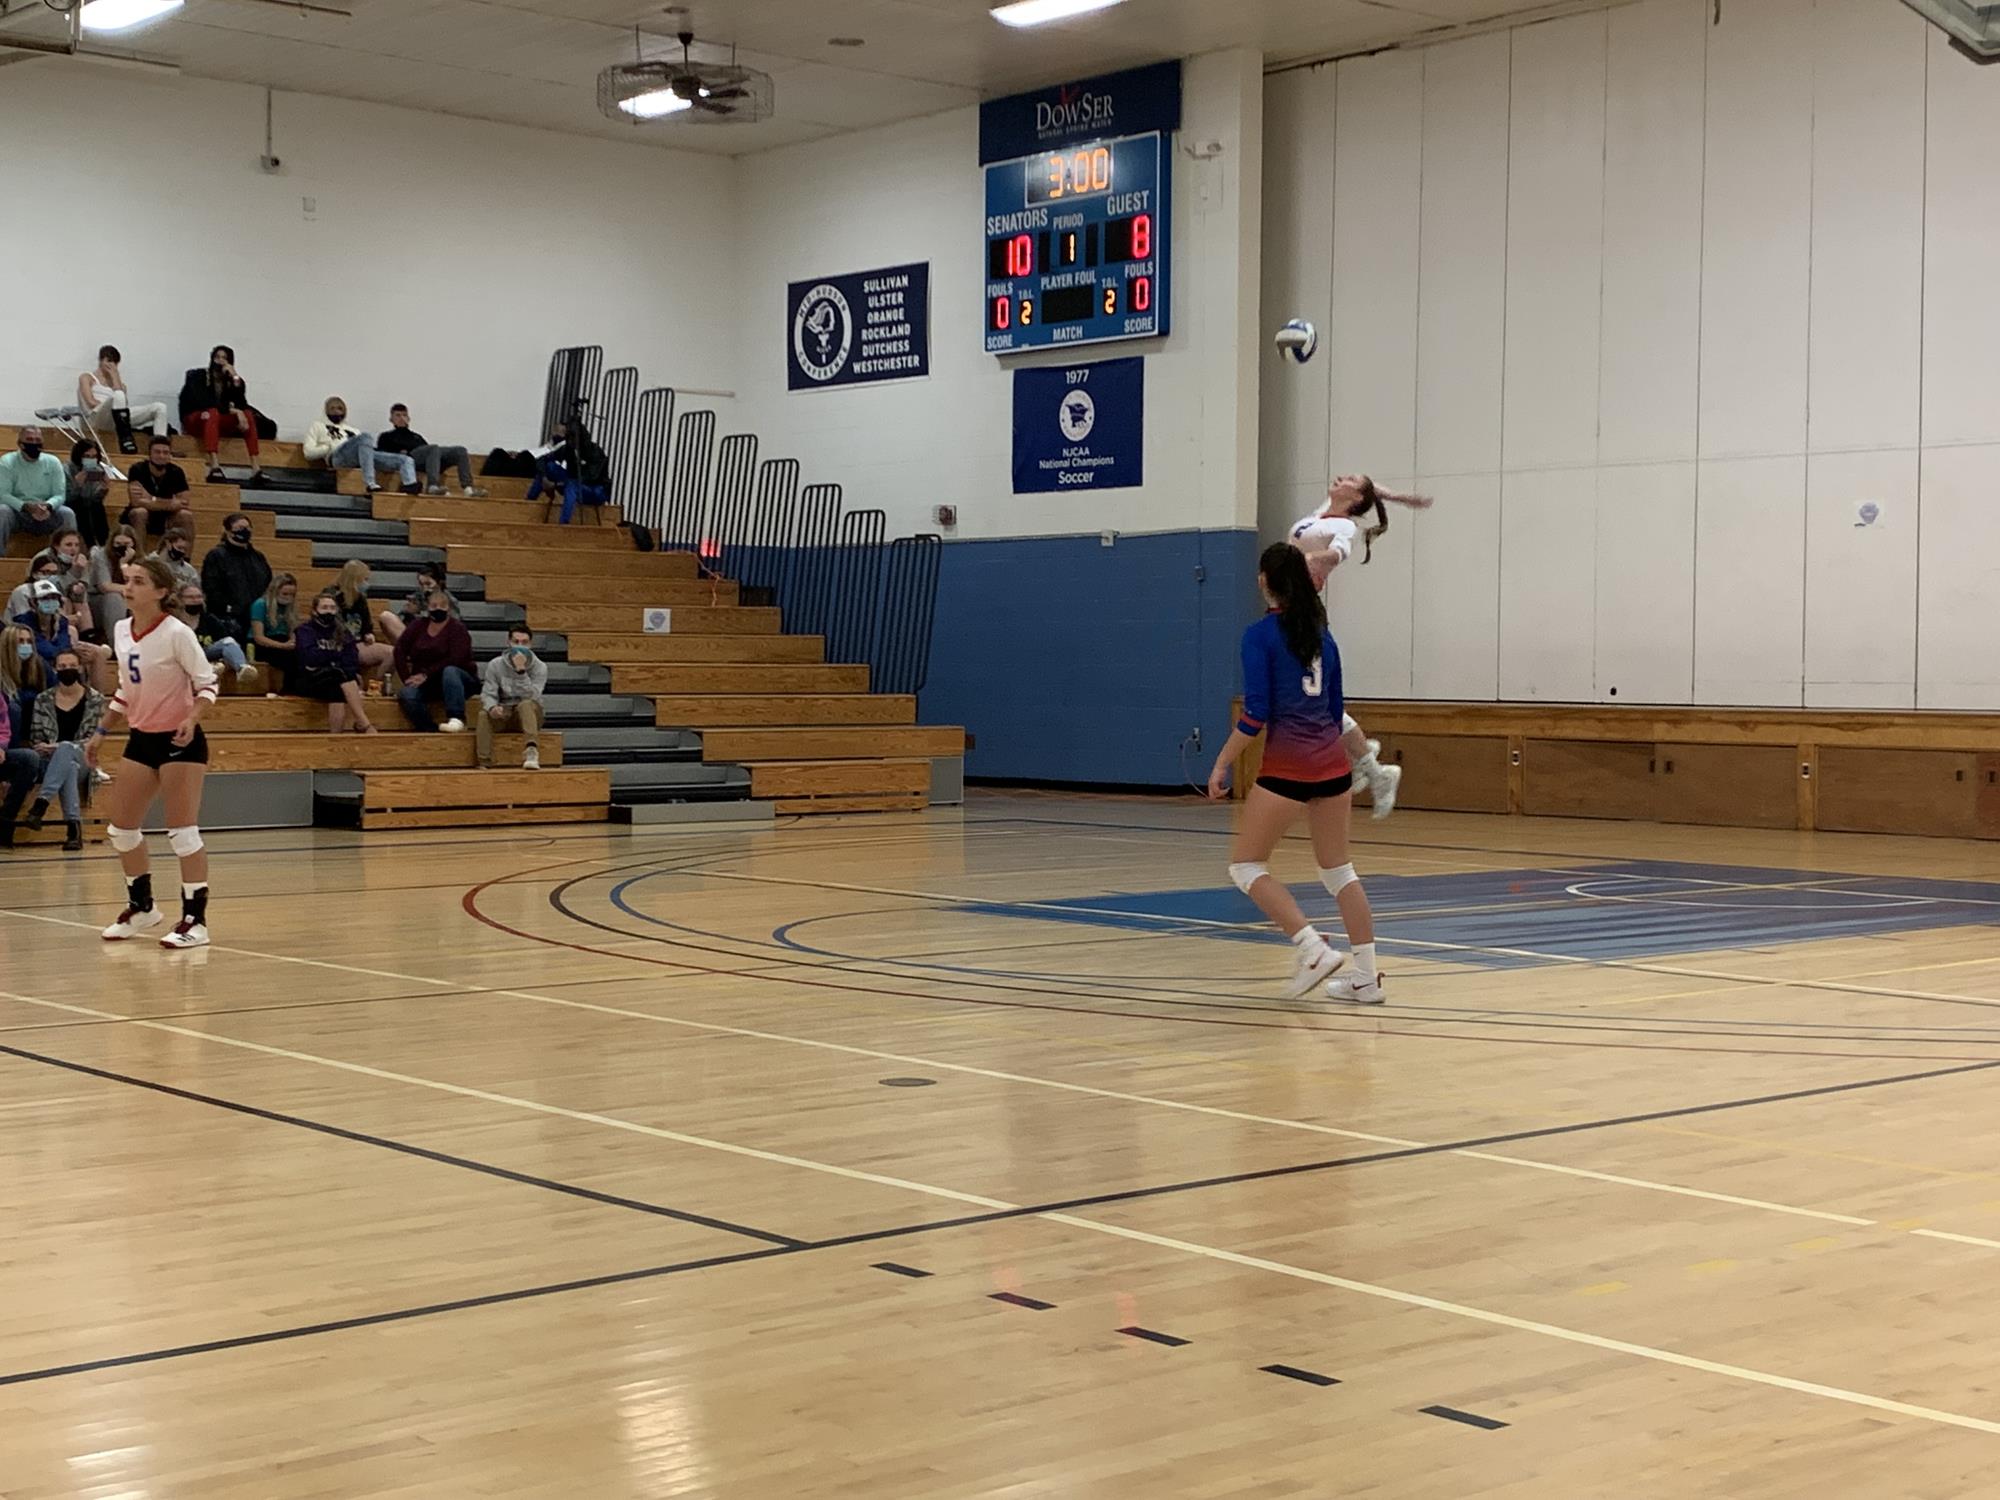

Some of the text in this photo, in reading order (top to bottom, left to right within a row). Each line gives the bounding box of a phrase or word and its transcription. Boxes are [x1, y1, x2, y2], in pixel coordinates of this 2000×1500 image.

[1049, 148, 1108, 198] 3:00
[1107, 190, 1150, 216] GUEST
[987, 208, 1048, 235] SENATORS
[1053, 213, 1084, 230] PERIOD
[1132, 214, 1151, 259] 8
[1007, 233, 1034, 277] 10
[1068, 233, 1076, 263] 1
[1124, 261, 1154, 278] FOULS
[863, 274, 909, 292] SULLIVAN
[1041, 270, 1097, 290] PLAYER FOUL
[987, 281, 1014, 298] FOULS
[1135, 276, 1150, 311] 0
[868, 292, 904, 308] ULSTER
[1104, 289, 1116, 315] 2
[867, 308, 904, 324] ORANGE
[996, 296, 1010, 329] 0
[1020, 300, 1032, 325] 2
[861, 324, 911, 340] ROCKLAND
[1124, 316, 1153, 333] SCORE
[987, 334, 1013, 350] SCORE
[1053, 326, 1083, 341] MATCH
[862, 340, 910, 357] DUTCHESS
[853, 355, 920, 374] WESTCHESTER
[1065, 369, 1089, 384] 1977
[1062, 447, 1090, 457] NJCAA
[1039, 455, 1114, 469] National Champions
[1058, 470, 1094, 484] Soccer
[127, 653, 142, 684] 5
